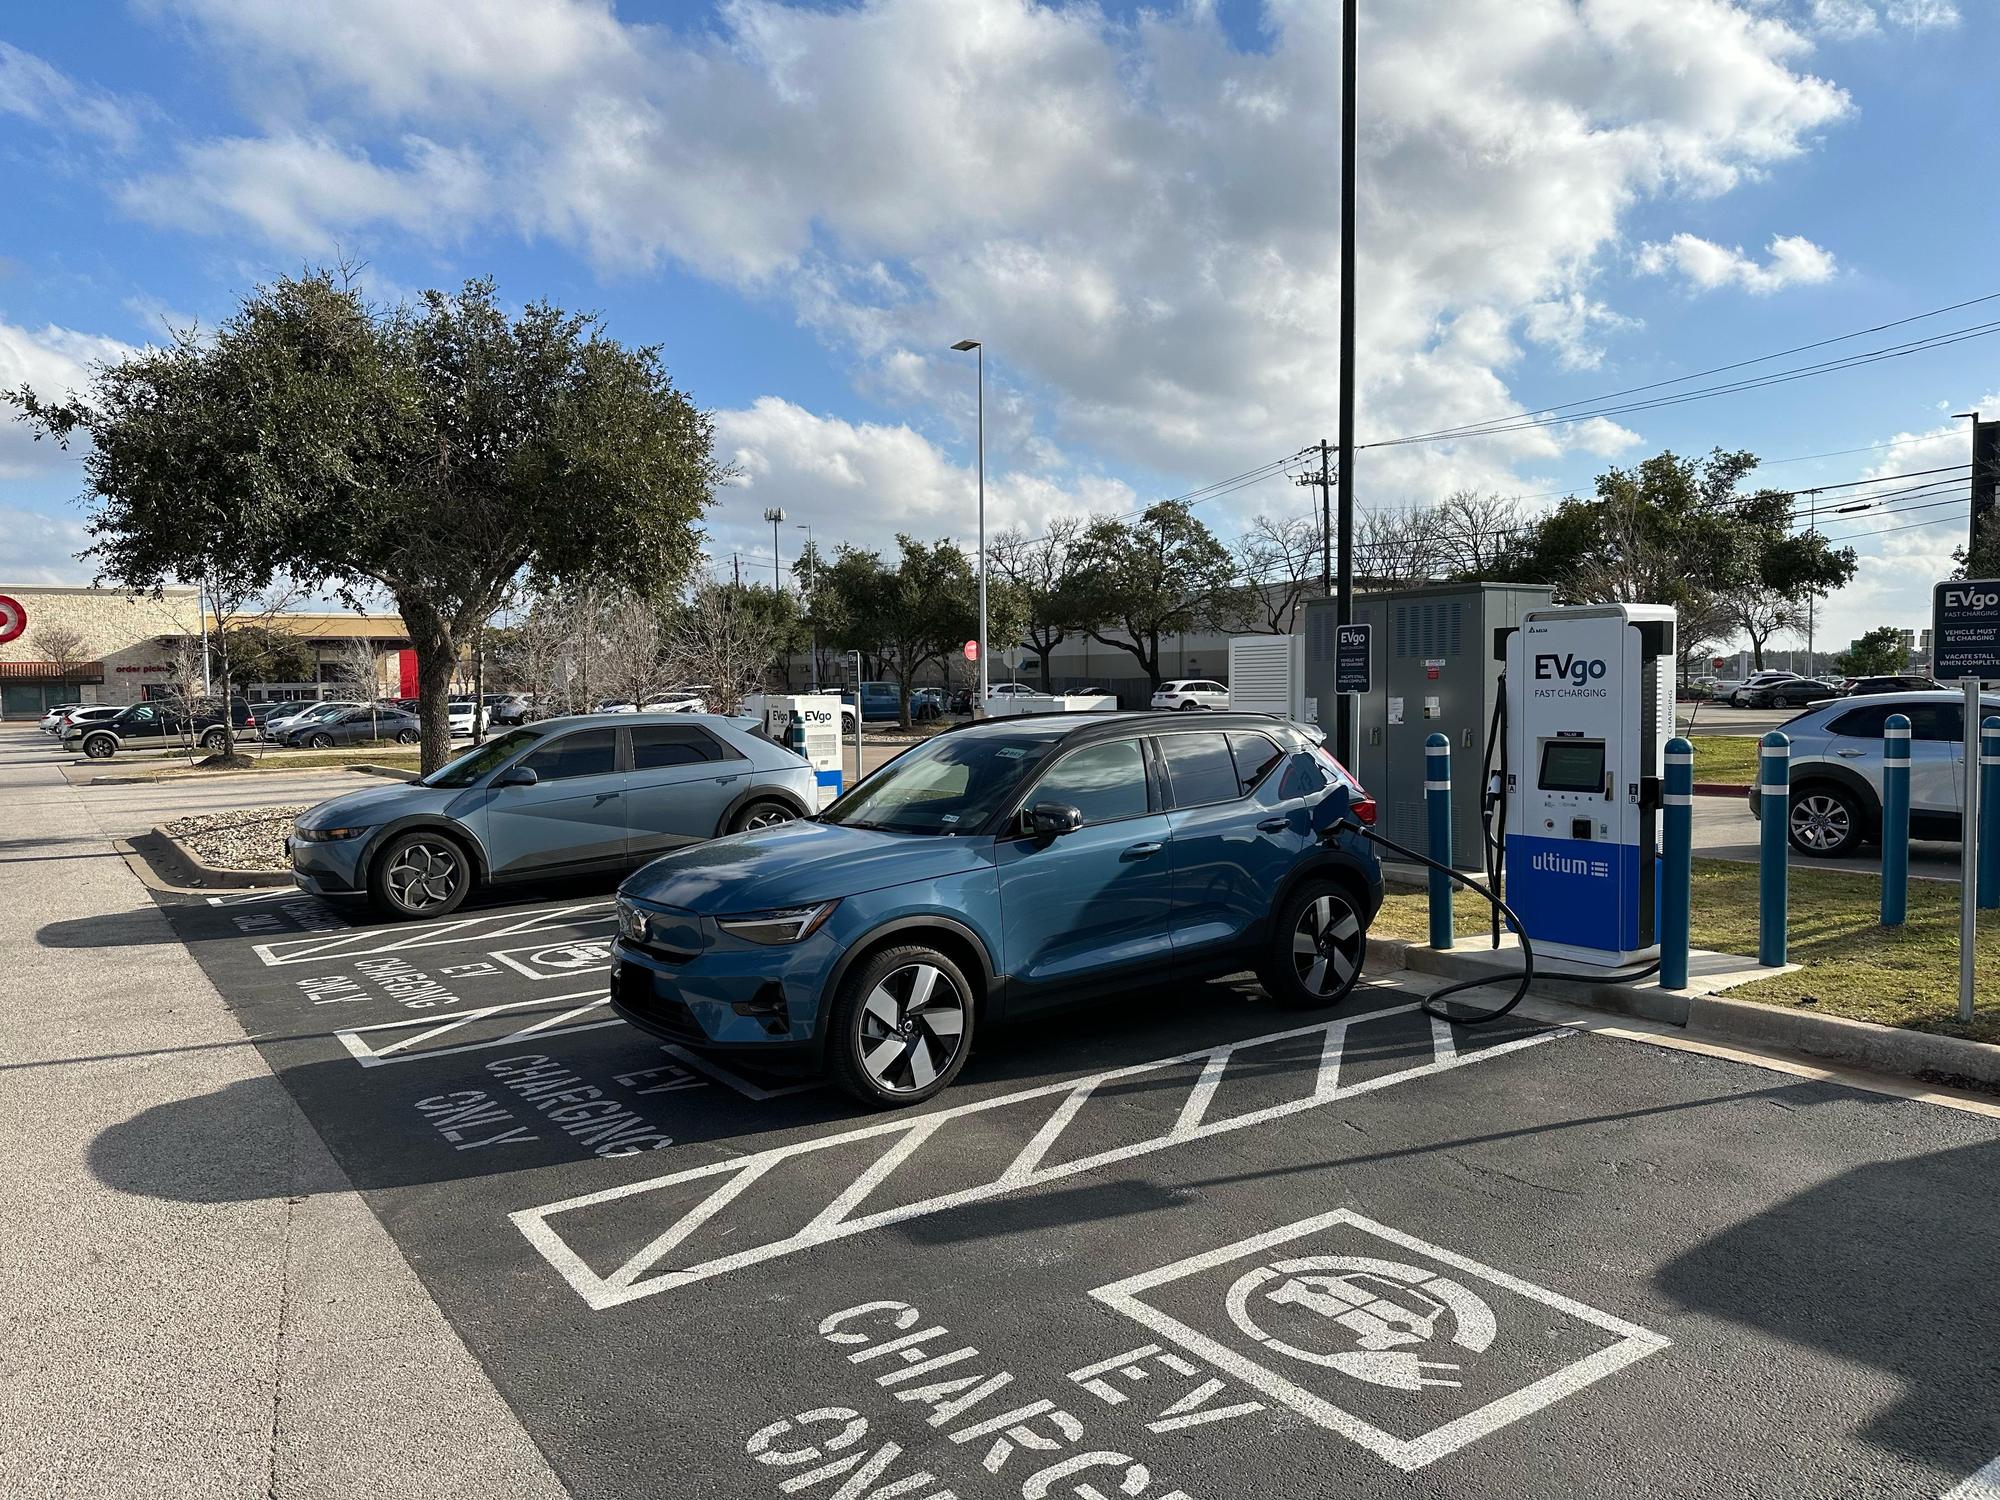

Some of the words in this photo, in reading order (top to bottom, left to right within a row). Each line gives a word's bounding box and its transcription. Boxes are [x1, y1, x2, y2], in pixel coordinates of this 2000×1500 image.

[1945, 591, 1998, 610] EVgo
[1341, 632, 1365, 645] EVgo
[116, 665, 140, 673] order
[143, 665, 170, 673] picku
[1535, 653, 1607, 687] EVgo
[1535, 689, 1556, 698] FAST
[1557, 688, 1607, 698] CHARGING
[773, 711, 787, 724] EVgo
[805, 711, 832, 723] EVgo
[1533, 852, 1587, 875] ultium
[354, 957, 460, 1009] CHARGING
[439, 962, 503, 978] EV
[295, 975, 373, 1005] ONLY
[611, 1065, 709, 1095] EV
[414, 1090, 539, 1151] ONLY
[484, 1054, 673, 1158] CHARGING
[818, 1300, 1195, 1500] CHARG
[1066, 1343, 1266, 1435] EV
[746, 1406, 957, 1500] ON
